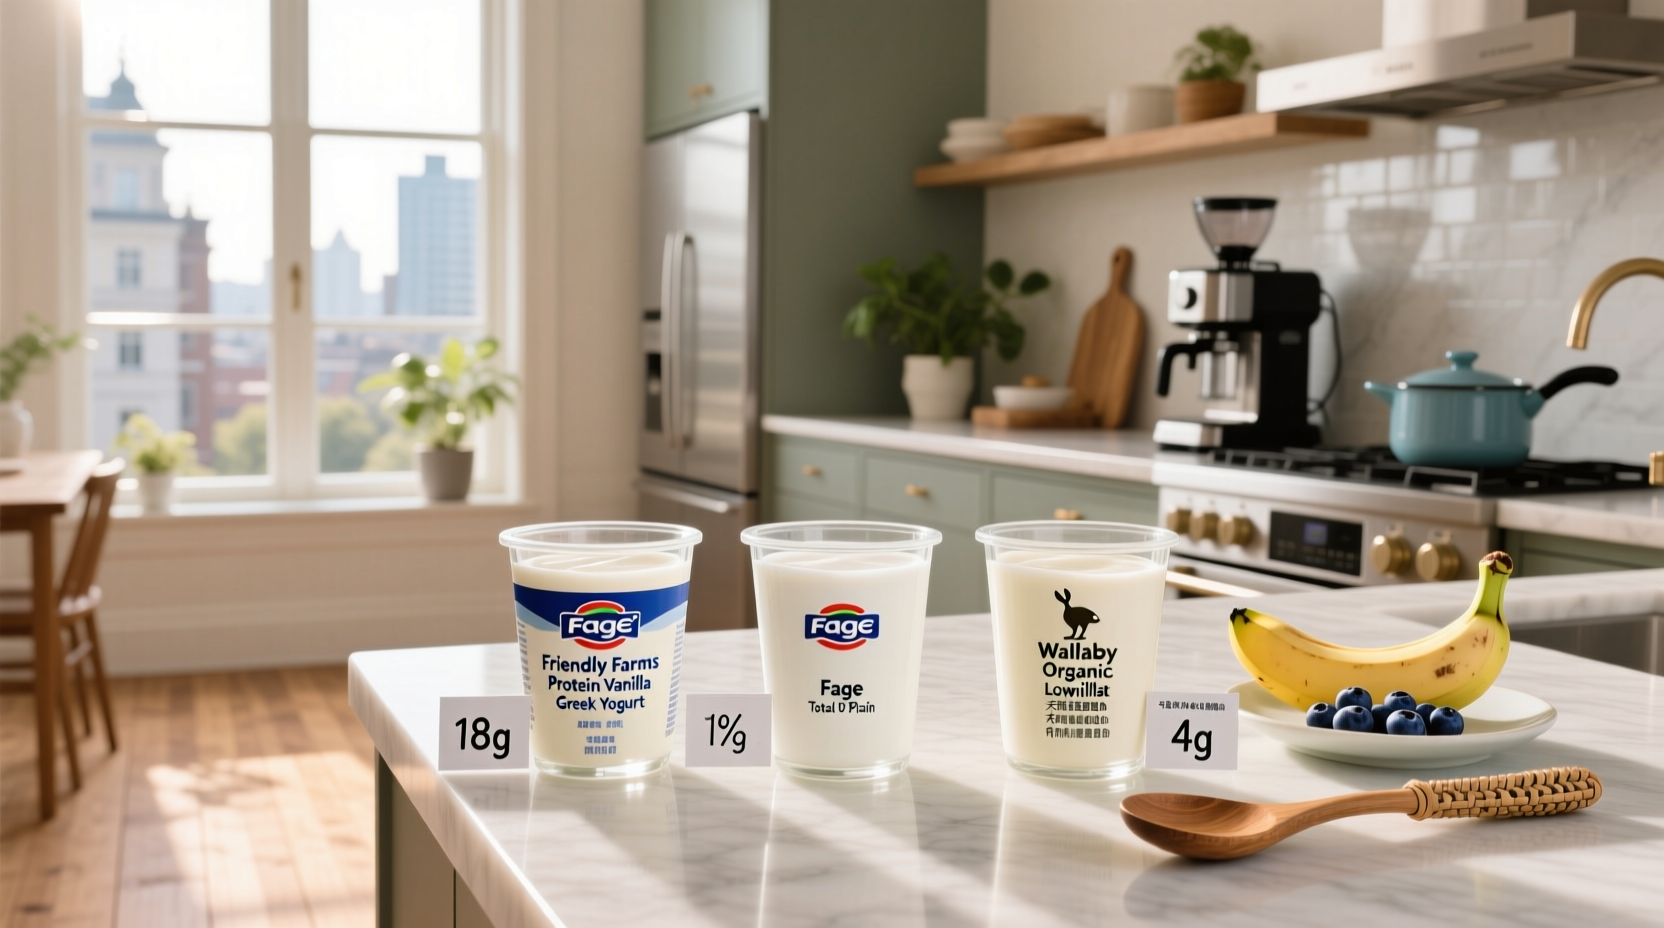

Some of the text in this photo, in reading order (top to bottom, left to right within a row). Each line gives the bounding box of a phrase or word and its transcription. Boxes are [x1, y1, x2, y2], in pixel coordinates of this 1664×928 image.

[811, 617, 874, 639] Fage
[1038, 642, 1117, 664] Wallaby
[542, 654, 659, 677] Friendly Farms
[1042, 662, 1113, 682] Organic
[548, 674, 651, 692] Protein Vanilla
[820, 679, 863, 701] Fage
[556, 695, 645, 714] Greek Yogurt
[808, 700, 835, 714] Total
[848, 701, 876, 714] Plain
[455, 716, 511, 760] 18g
[1171, 719, 1213, 762] 4g
